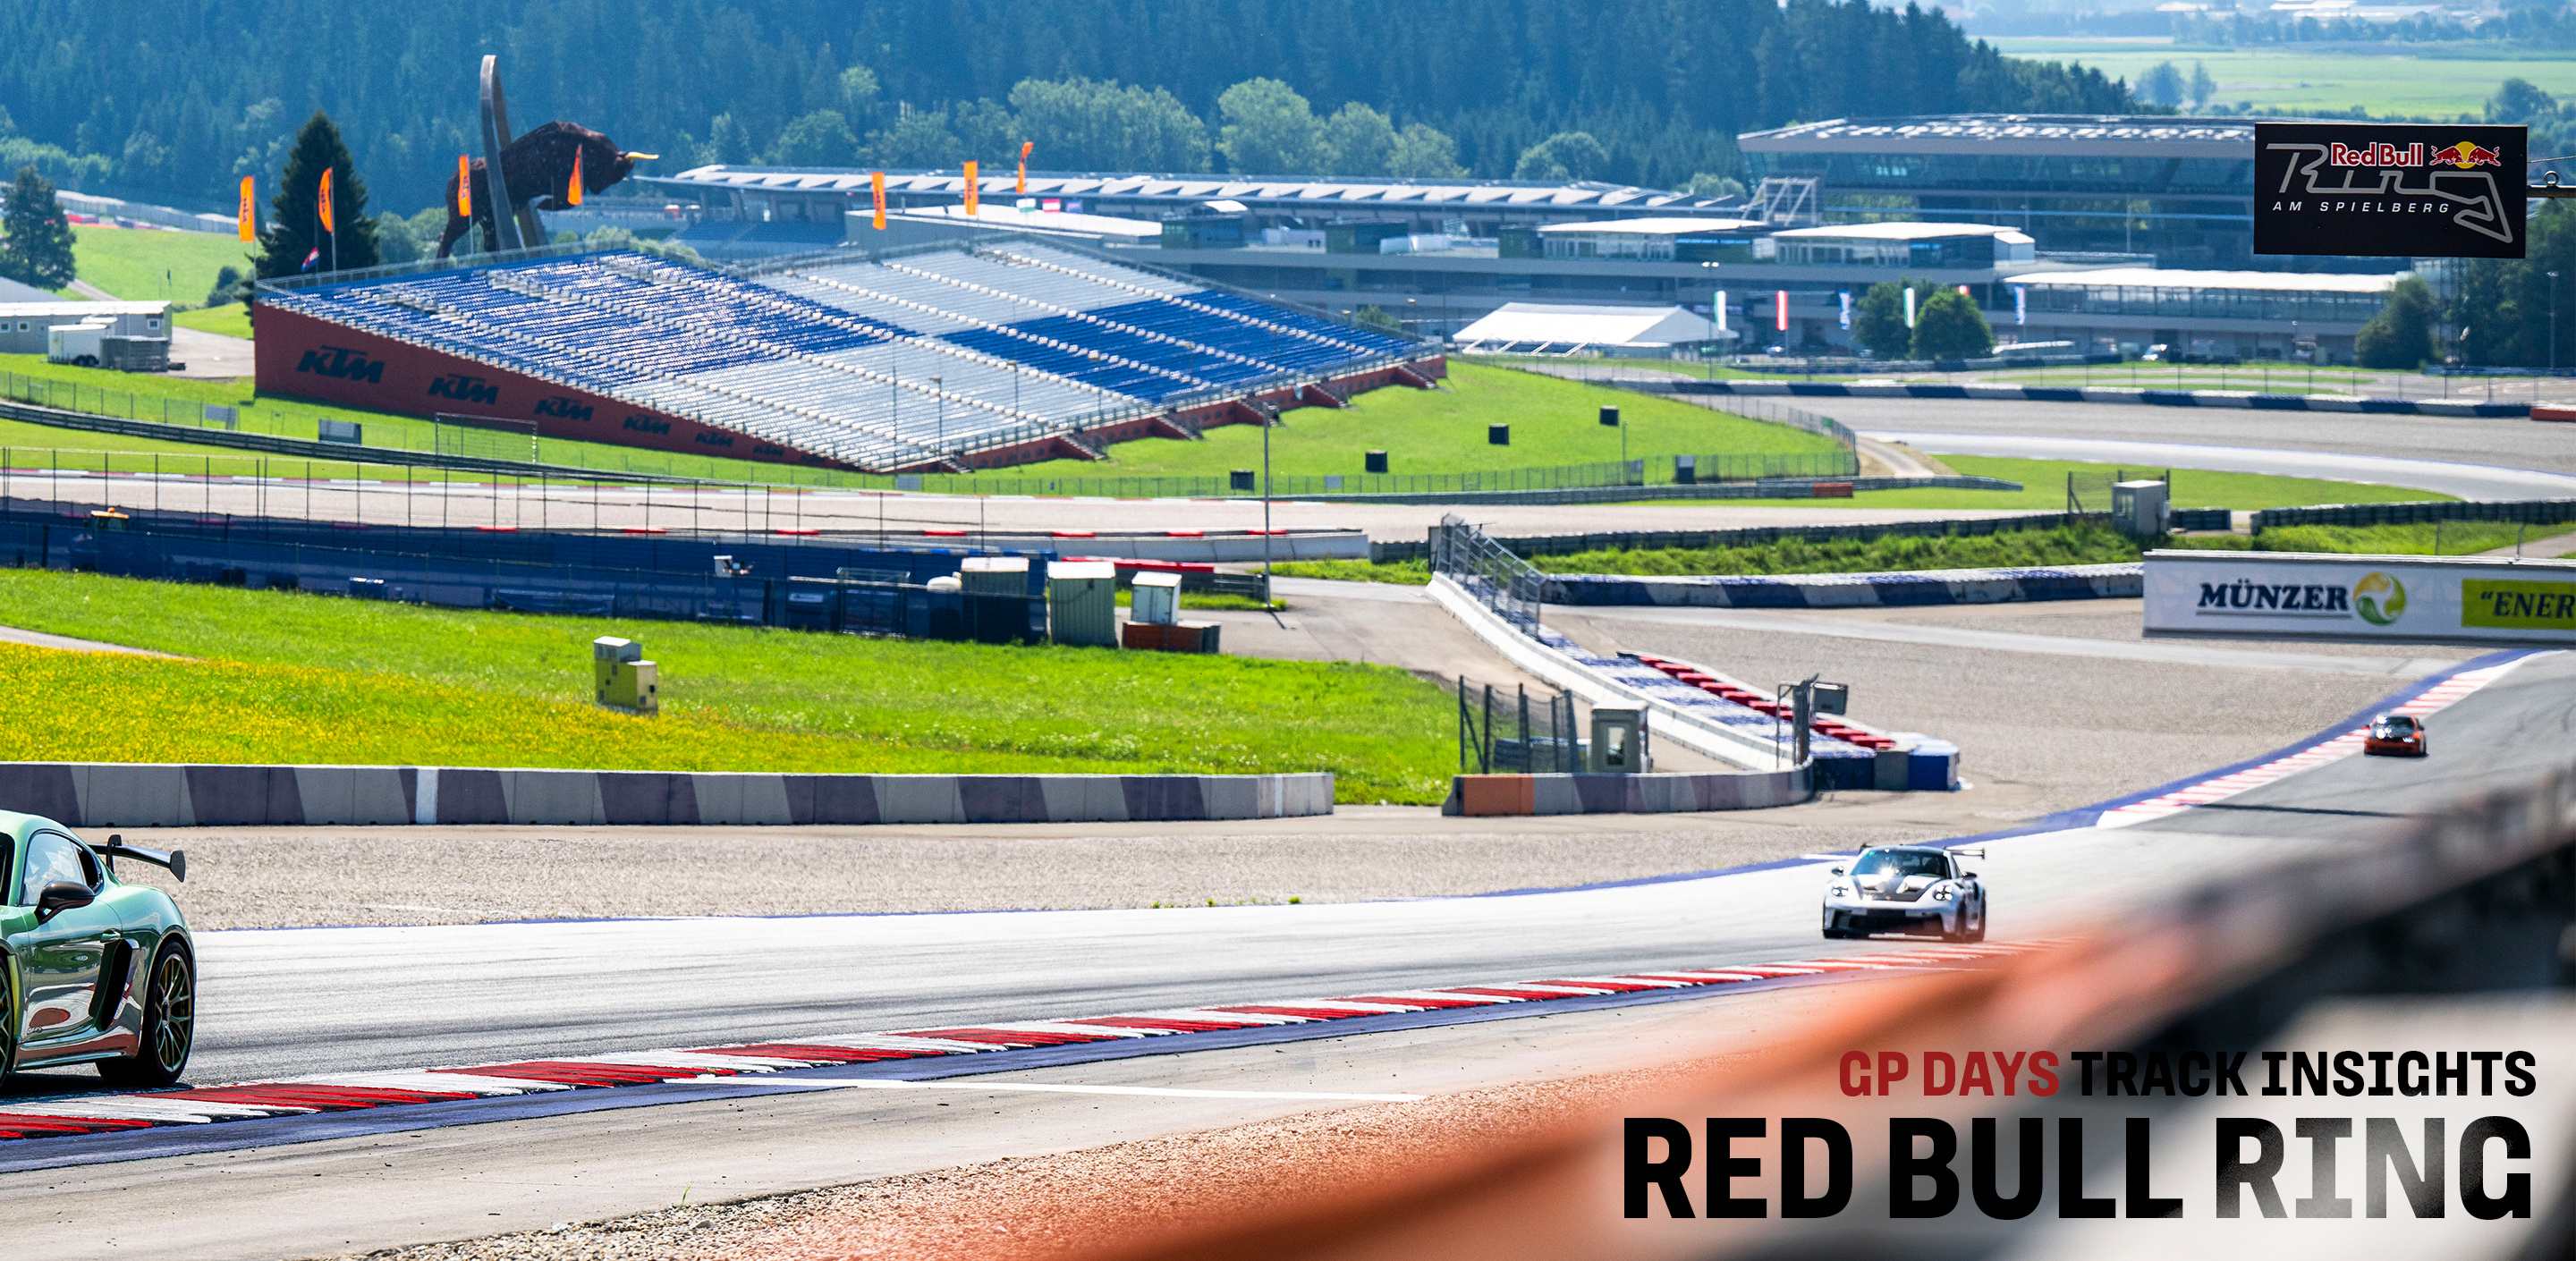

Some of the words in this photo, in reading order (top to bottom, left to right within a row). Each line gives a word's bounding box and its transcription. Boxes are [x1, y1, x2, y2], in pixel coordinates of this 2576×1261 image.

[2331, 142, 2377, 166] Red
[2378, 143, 2423, 167] Bull
[2273, 201, 2302, 211] AM
[2319, 202, 2449, 213] SPIELBERG
[297, 345, 386, 384] KTM
[428, 374, 499, 404] KTM
[534, 396, 594, 421] KTM
[623, 413, 671, 435] KTM
[2197, 579, 2350, 611] MÜNZER
